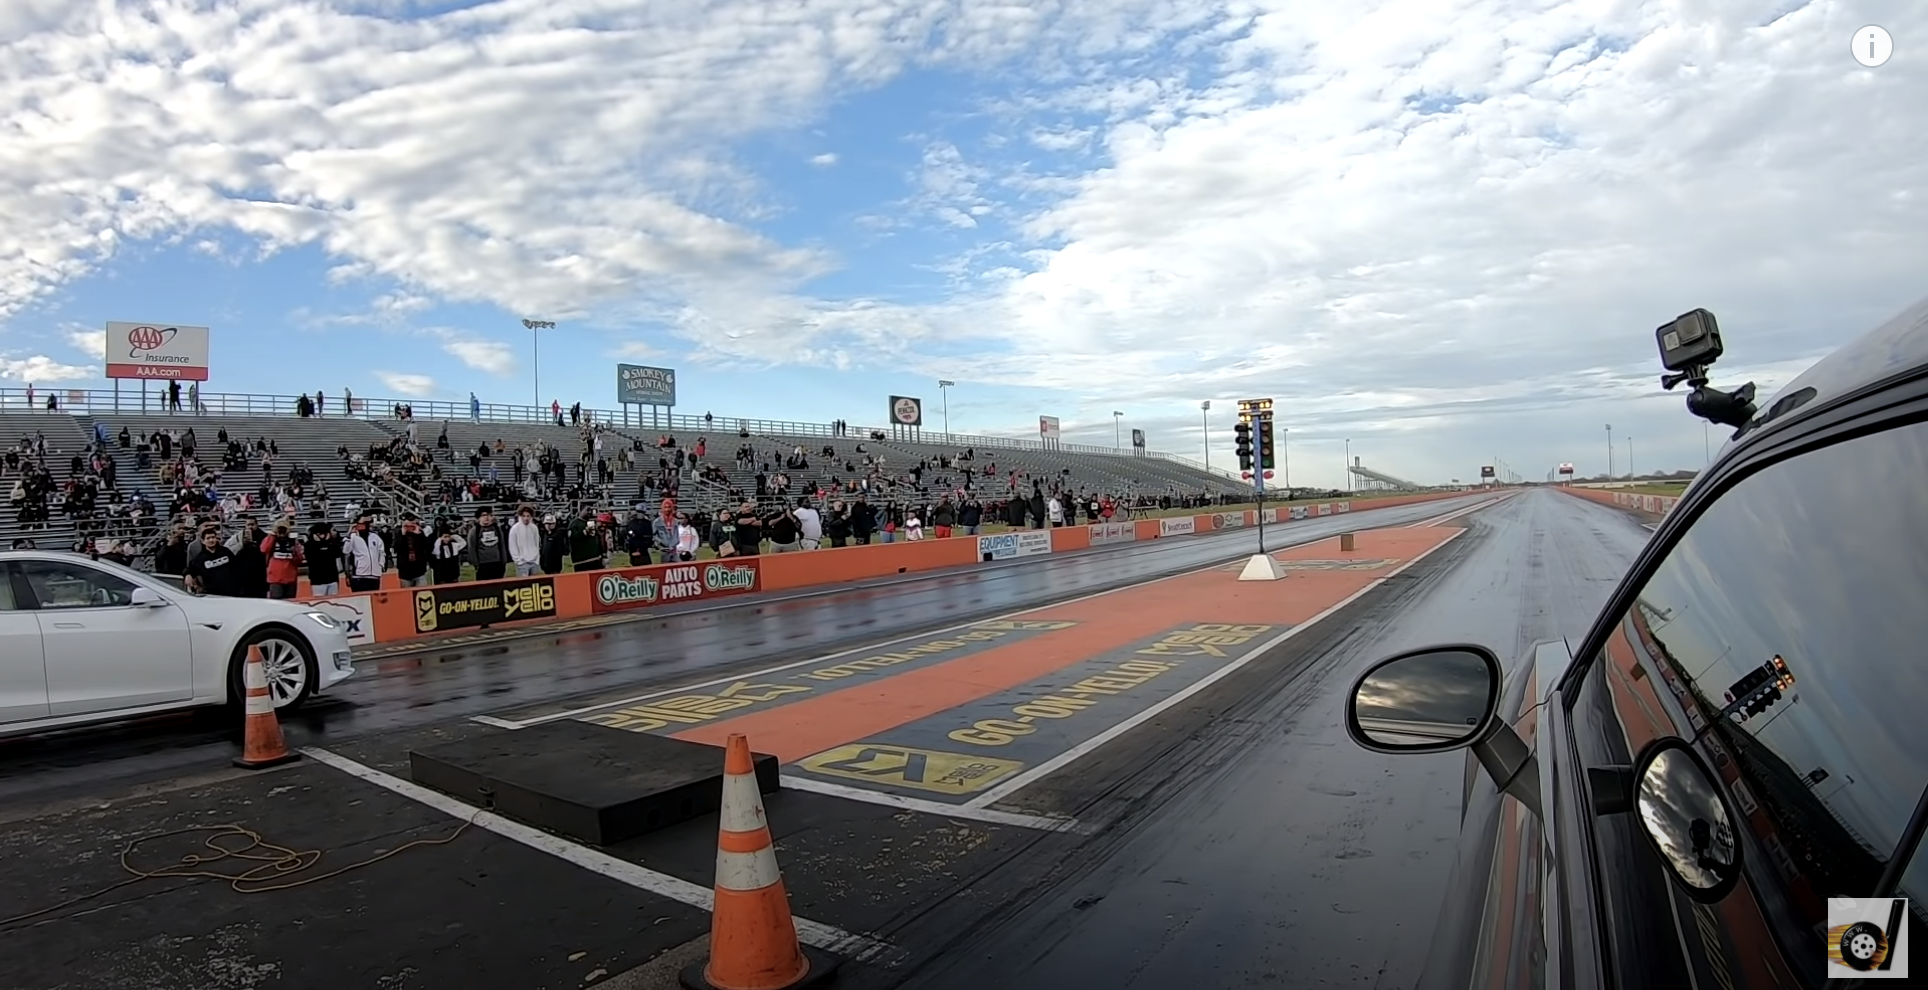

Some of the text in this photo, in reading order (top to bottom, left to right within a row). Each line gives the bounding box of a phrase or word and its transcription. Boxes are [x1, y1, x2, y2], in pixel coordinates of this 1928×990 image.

[145, 353, 189, 364] Insurance
[136, 366, 181, 377] AAA.com
[630, 368, 666, 381] SMOKEY
[625, 378, 672, 394] MOUNTAIN
[981, 534, 1019, 551] EQUIPMENT
[665, 566, 698, 583] AUTO
[706, 566, 755, 589] O'Reilly
[599, 575, 657, 602] O'Reilly
[661, 580, 702, 599] PARTS
